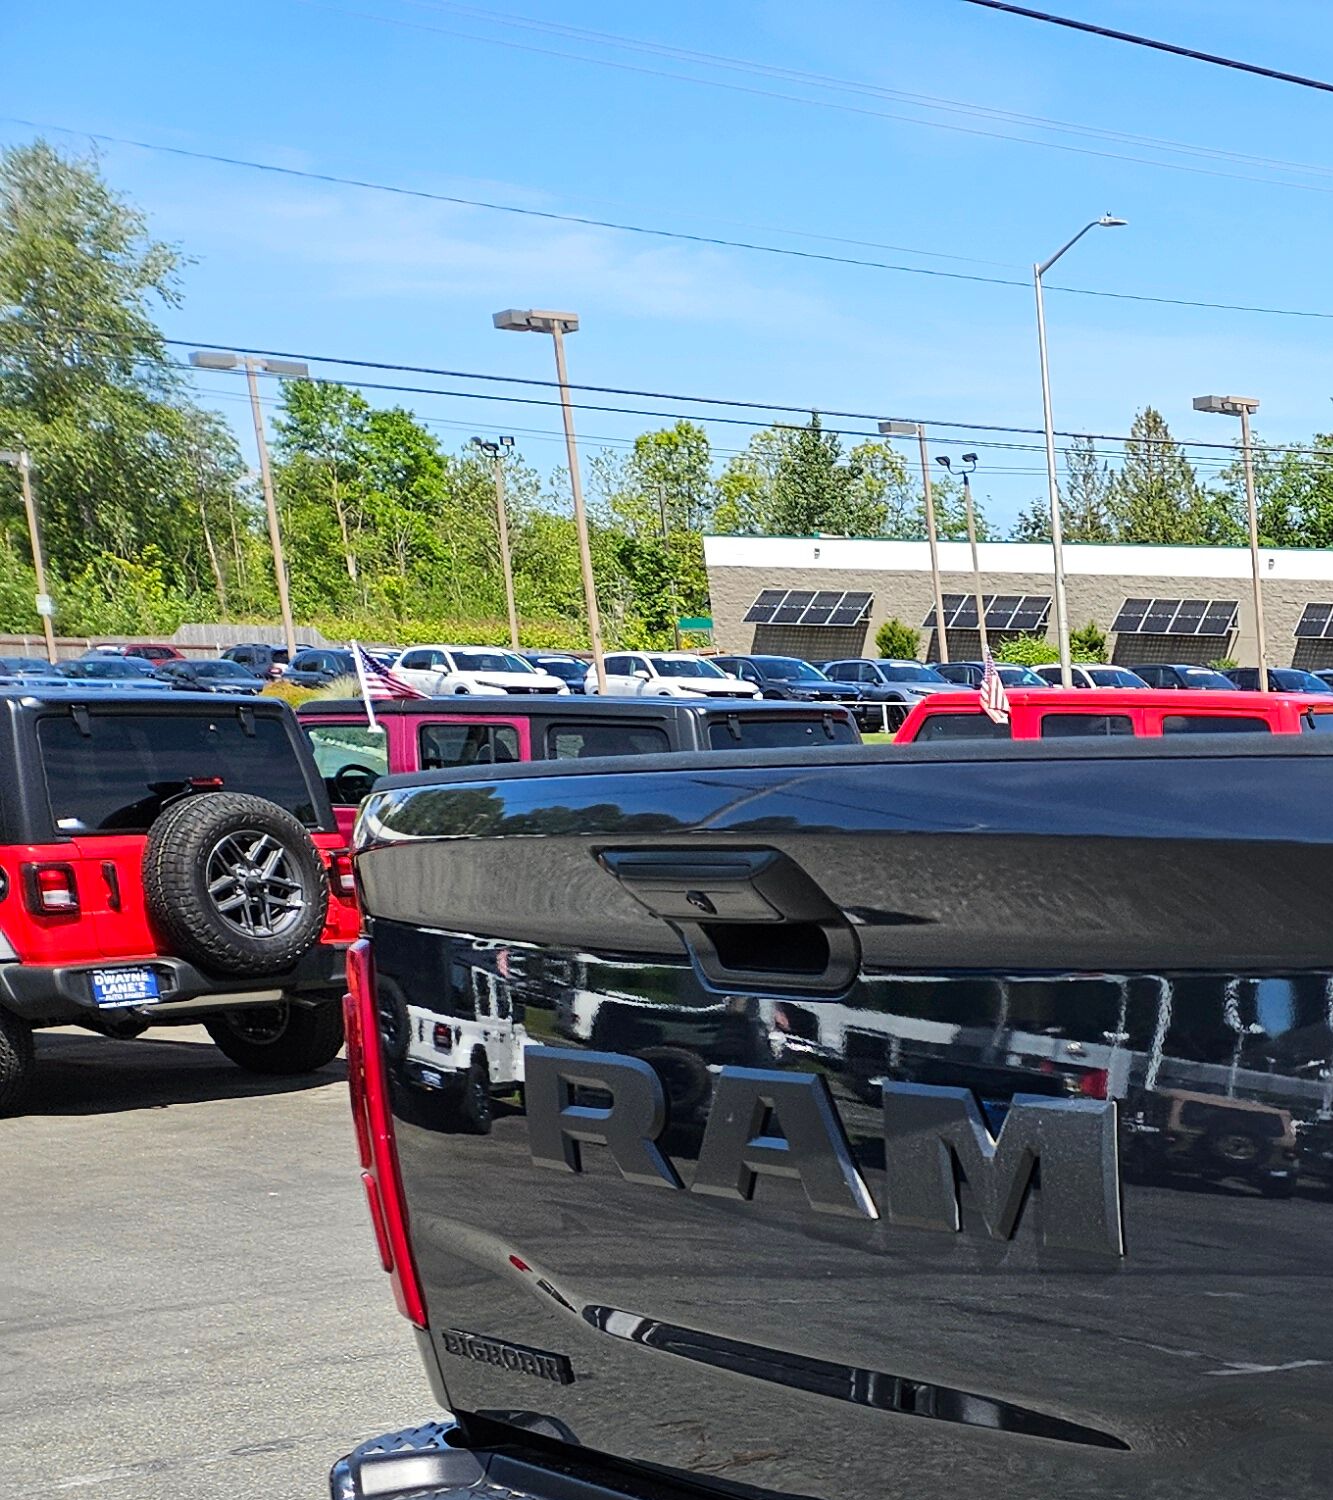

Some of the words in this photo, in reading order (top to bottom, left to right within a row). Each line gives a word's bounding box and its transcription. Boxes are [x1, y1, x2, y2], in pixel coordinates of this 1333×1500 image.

[94, 972, 149, 985] DWAYNE
[101, 982, 146, 995] LANE'S
[524, 1045, 1125, 1257] RAM
